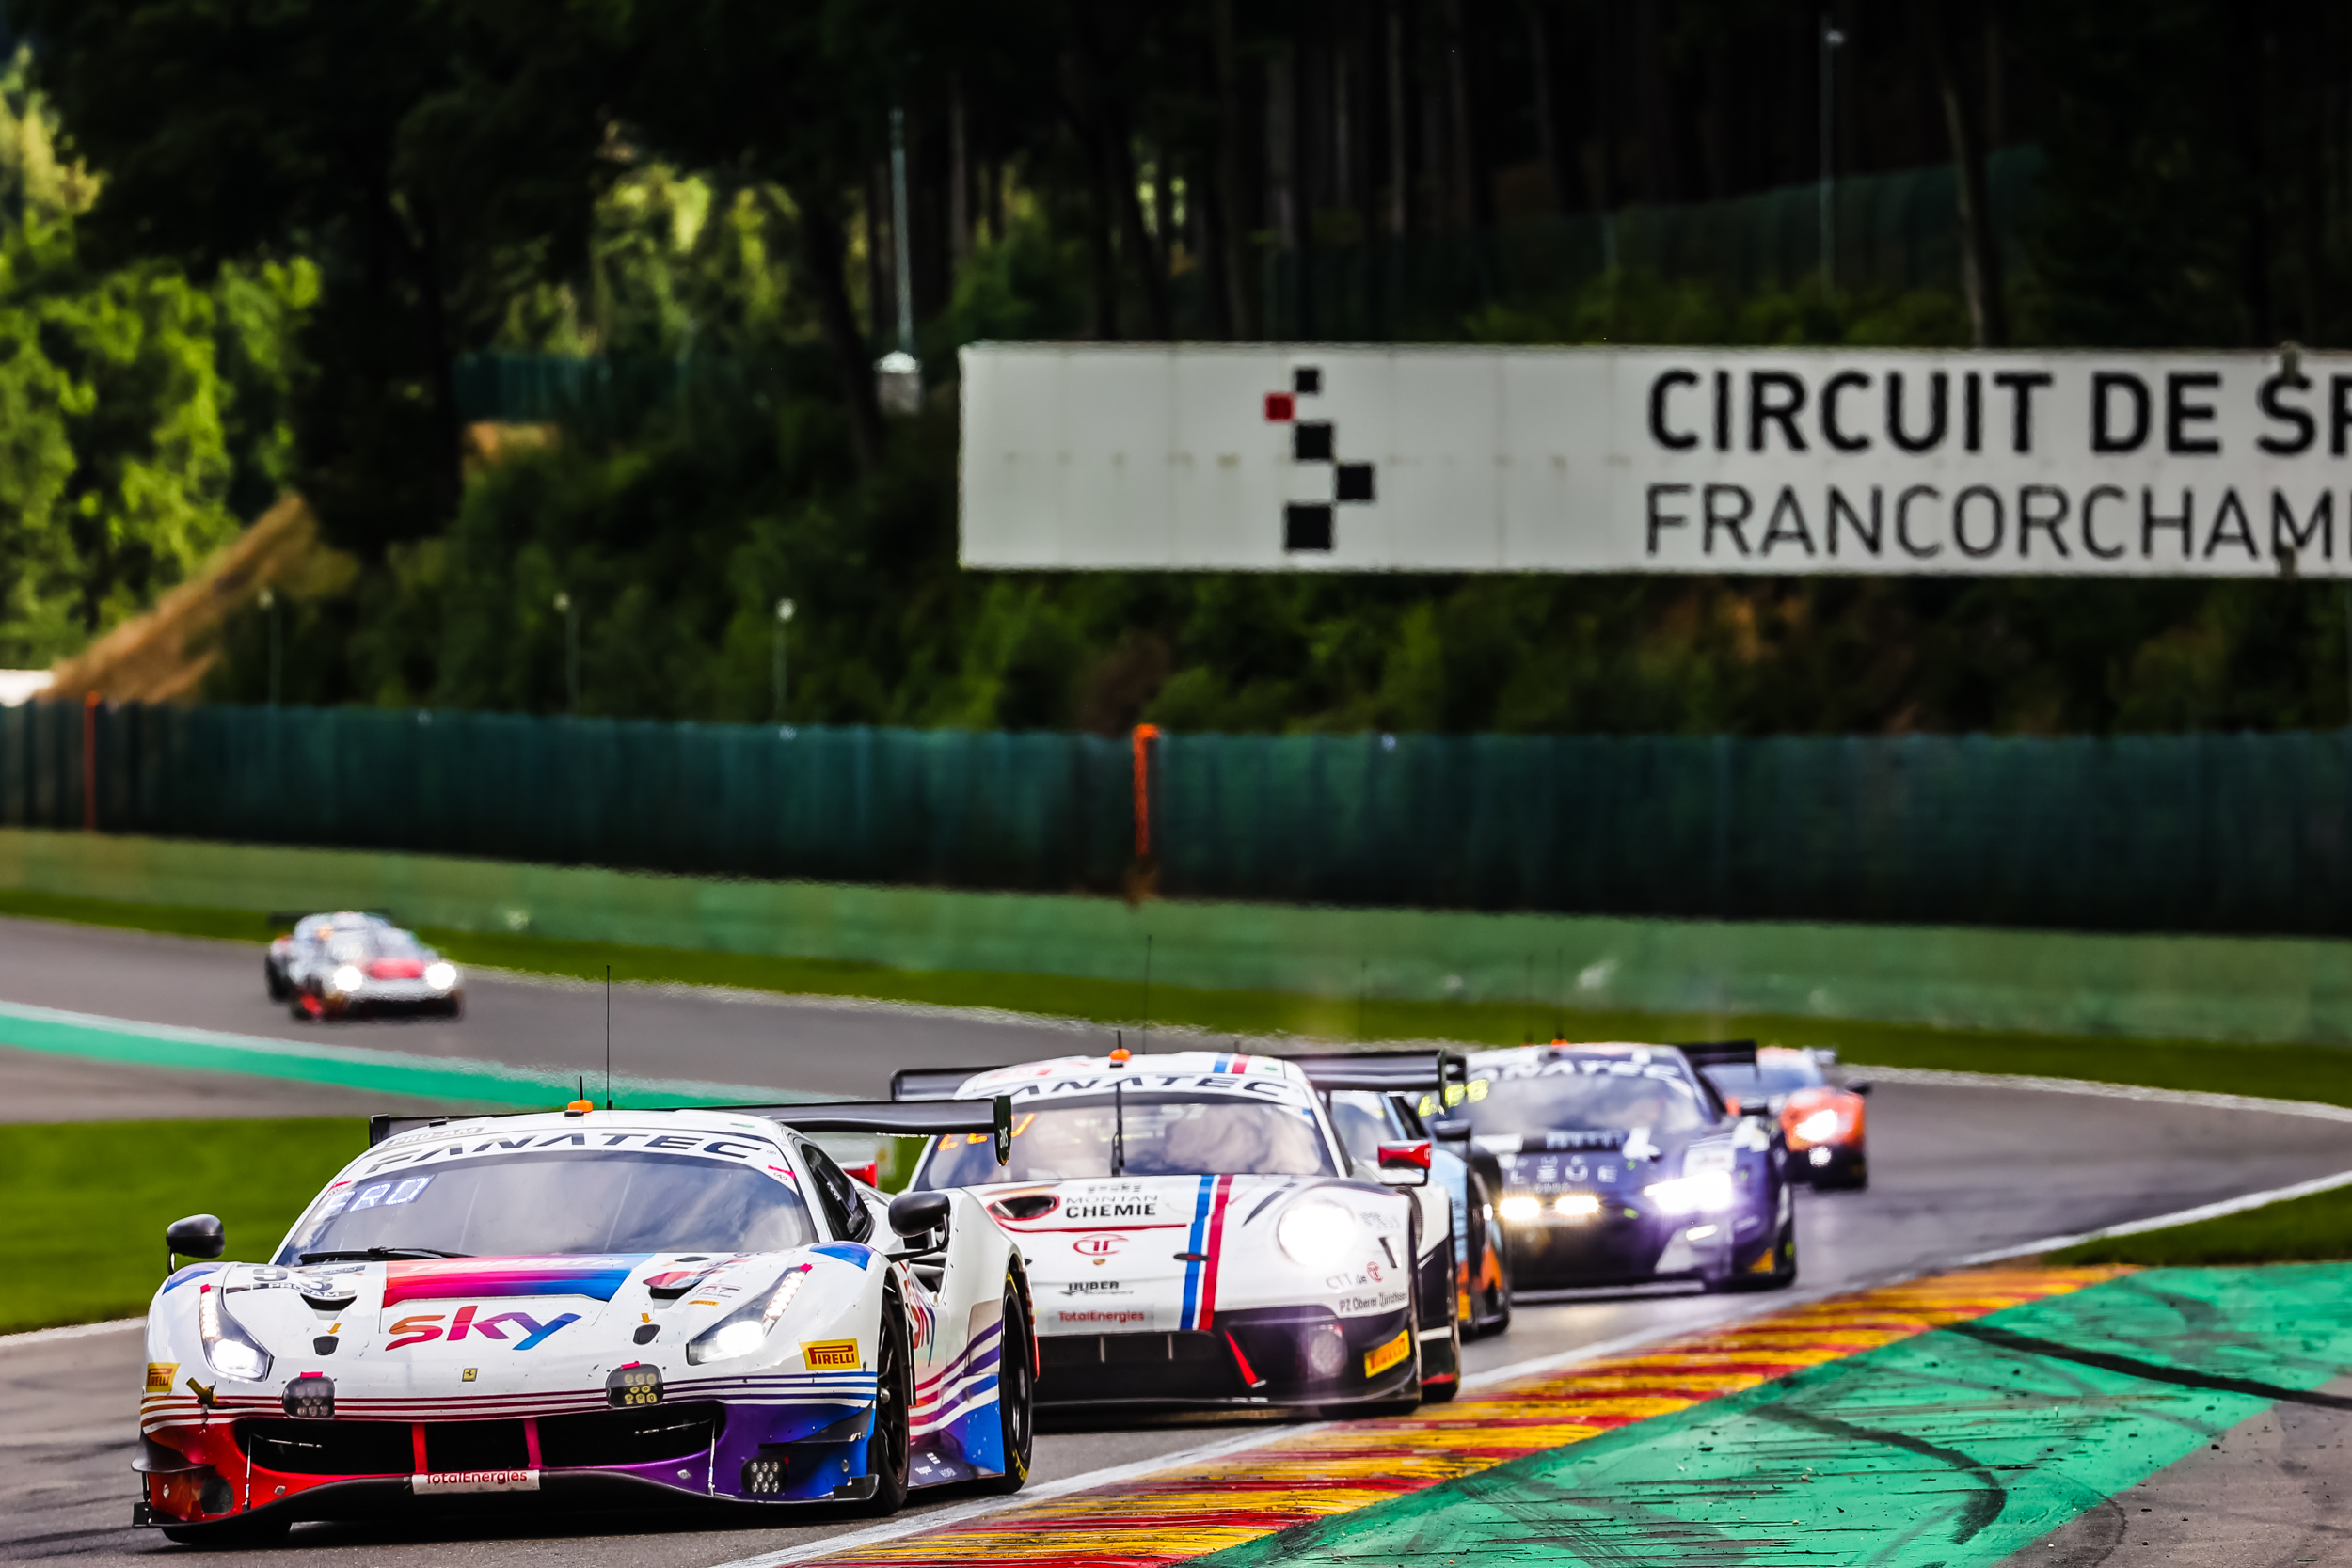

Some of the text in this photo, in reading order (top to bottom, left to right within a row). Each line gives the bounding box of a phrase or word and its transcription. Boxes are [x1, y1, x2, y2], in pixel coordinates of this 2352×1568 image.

[1649, 369, 2055, 455] CIRCUIT
[2090, 371, 2221, 455] DE
[1647, 483, 2352, 560] FRANCORCHAM
[390, 1127, 479, 1146] PRO-AM
[364, 1132, 762, 1175] FANATEC
[1066, 1204, 1157, 1218] CHEMIE
[1058, 1310, 1145, 1323] TotalEnergies
[385, 1306, 582, 1351] sky
[808, 1345, 855, 1364] PIRELLI
[147, 1368, 173, 1386] PIRELLI
[427, 1470, 528, 1484] TotalEnergies
